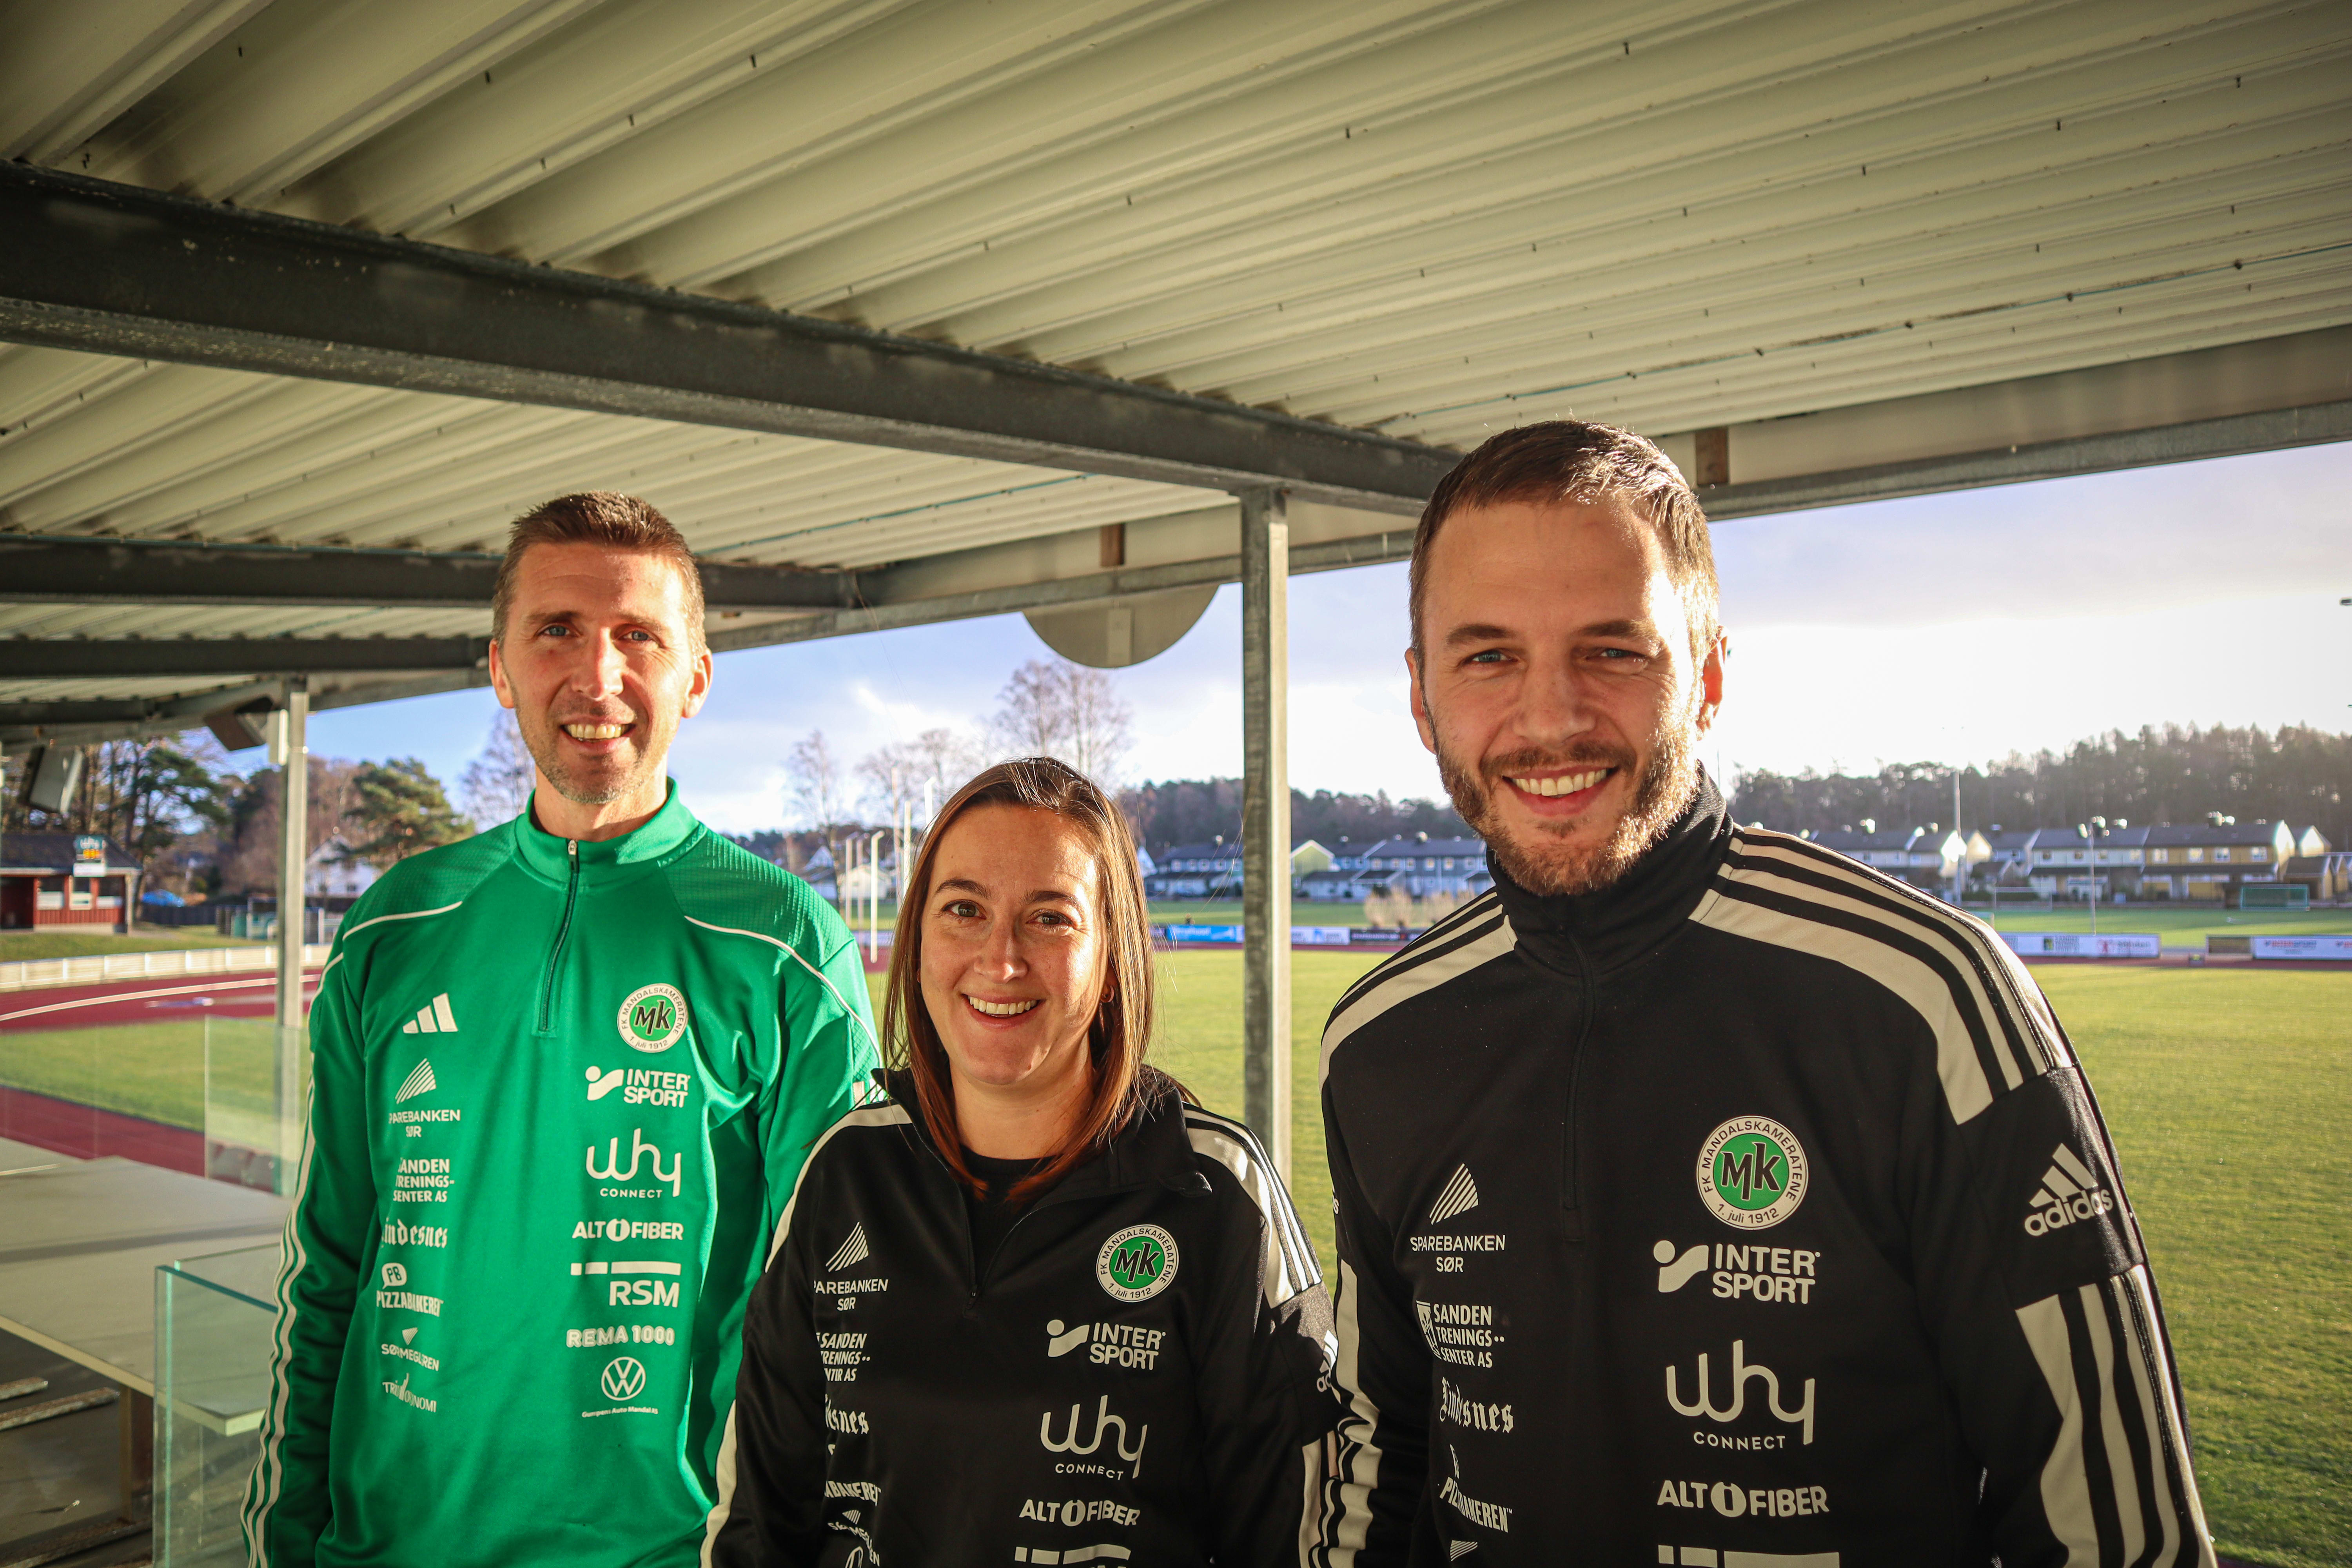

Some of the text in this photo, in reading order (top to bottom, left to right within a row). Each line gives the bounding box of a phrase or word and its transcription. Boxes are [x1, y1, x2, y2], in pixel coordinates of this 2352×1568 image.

[621, 987, 684, 1034] FK MANDALSKAMERATENE
[635, 1040, 646, 1049] juli
[649, 1040, 668, 1049] 1912
[626, 1068, 688, 1091] INTER
[623, 1088, 688, 1108] SPORT
[397, 1158, 450, 1174] ANDEN
[586, 1127, 682, 1198] why
[1702, 1121, 1802, 1202] FK MANDALSKAMERATENE
[1720, 1142, 1781, 1201] MK
[393, 1190, 448, 1203] SENTER AS
[600, 1188, 662, 1198] CONNECT
[1717, 1203, 1780, 1224] 1. juli 1912
[2024, 1189, 2113, 1236] adidas
[382, 1218, 448, 1248] indesnes
[1410, 1235, 1506, 1251] SPAREBANKEN
[1100, 1228, 1174, 1284] FK MANDALSKAMERATENE
[1114, 1242, 1160, 1282] MK
[1436, 1256, 1464, 1273] SØR
[1715, 1243, 1815, 1277] INTER
[609, 1279, 680, 1308] RSM
[1108, 1283, 1152, 1298] 1. juli 1912
[1712, 1271, 1816, 1304] SPORT
[837, 1297, 856, 1311] SØR
[1433, 1303, 1492, 1326] SANDEN
[566, 1325, 675, 1348] REMA 1000
[1093, 1322, 1162, 1350] INTER
[1089, 1343, 1159, 1370] SPORT
[1440, 1347, 1493, 1368] SENTER AS
[844, 1368, 857, 1381] AS
[1666, 1339, 1815, 1445] why
[1040, 1394, 1148, 1479] why
[1693, 1431, 1786, 1450] CONNECT
[1055, 1463, 1124, 1481] CONNECT
